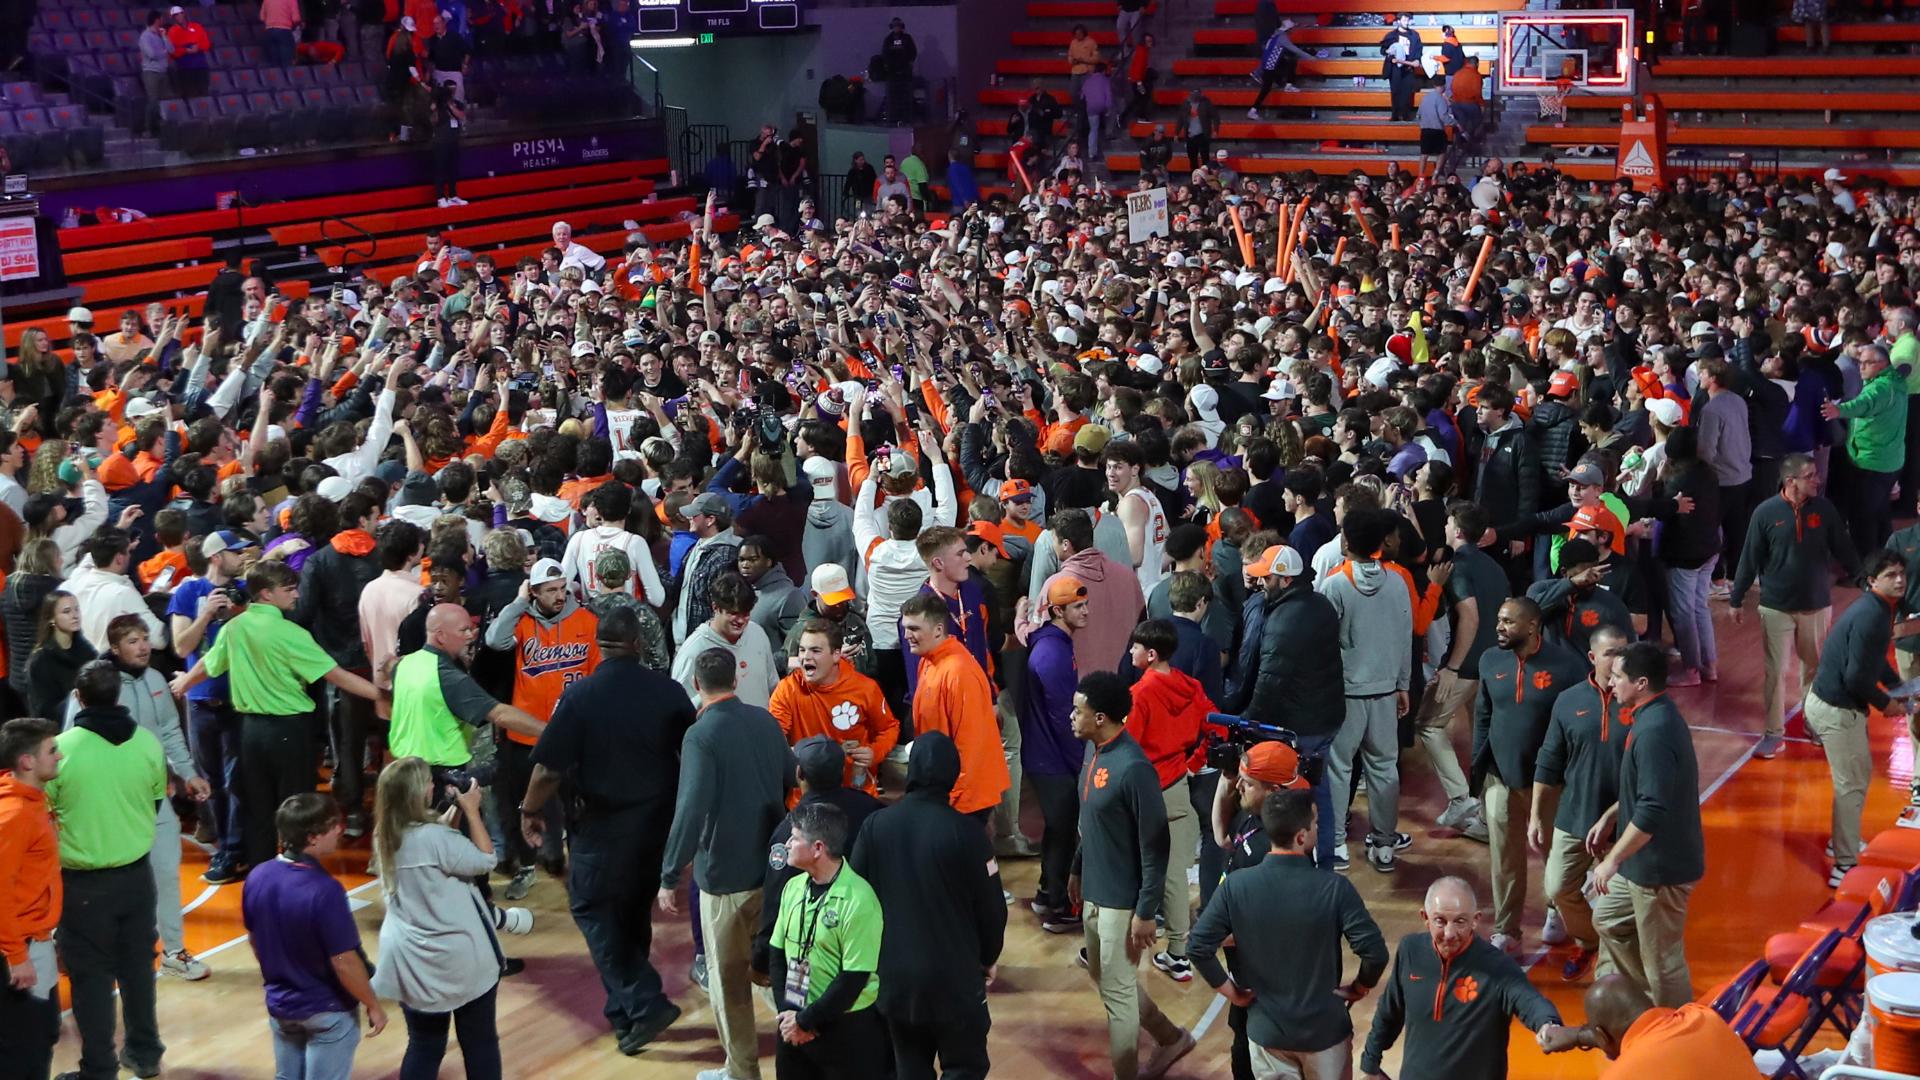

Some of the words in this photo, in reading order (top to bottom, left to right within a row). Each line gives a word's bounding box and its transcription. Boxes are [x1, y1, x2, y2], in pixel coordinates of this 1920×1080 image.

[718, 18, 730, 26] FLS
[700, 33, 714, 44] EXIT
[513, 138, 565, 157] PRISMA
[523, 156, 557, 168] HEALTH
[1623, 166, 1654, 175] CITGO
